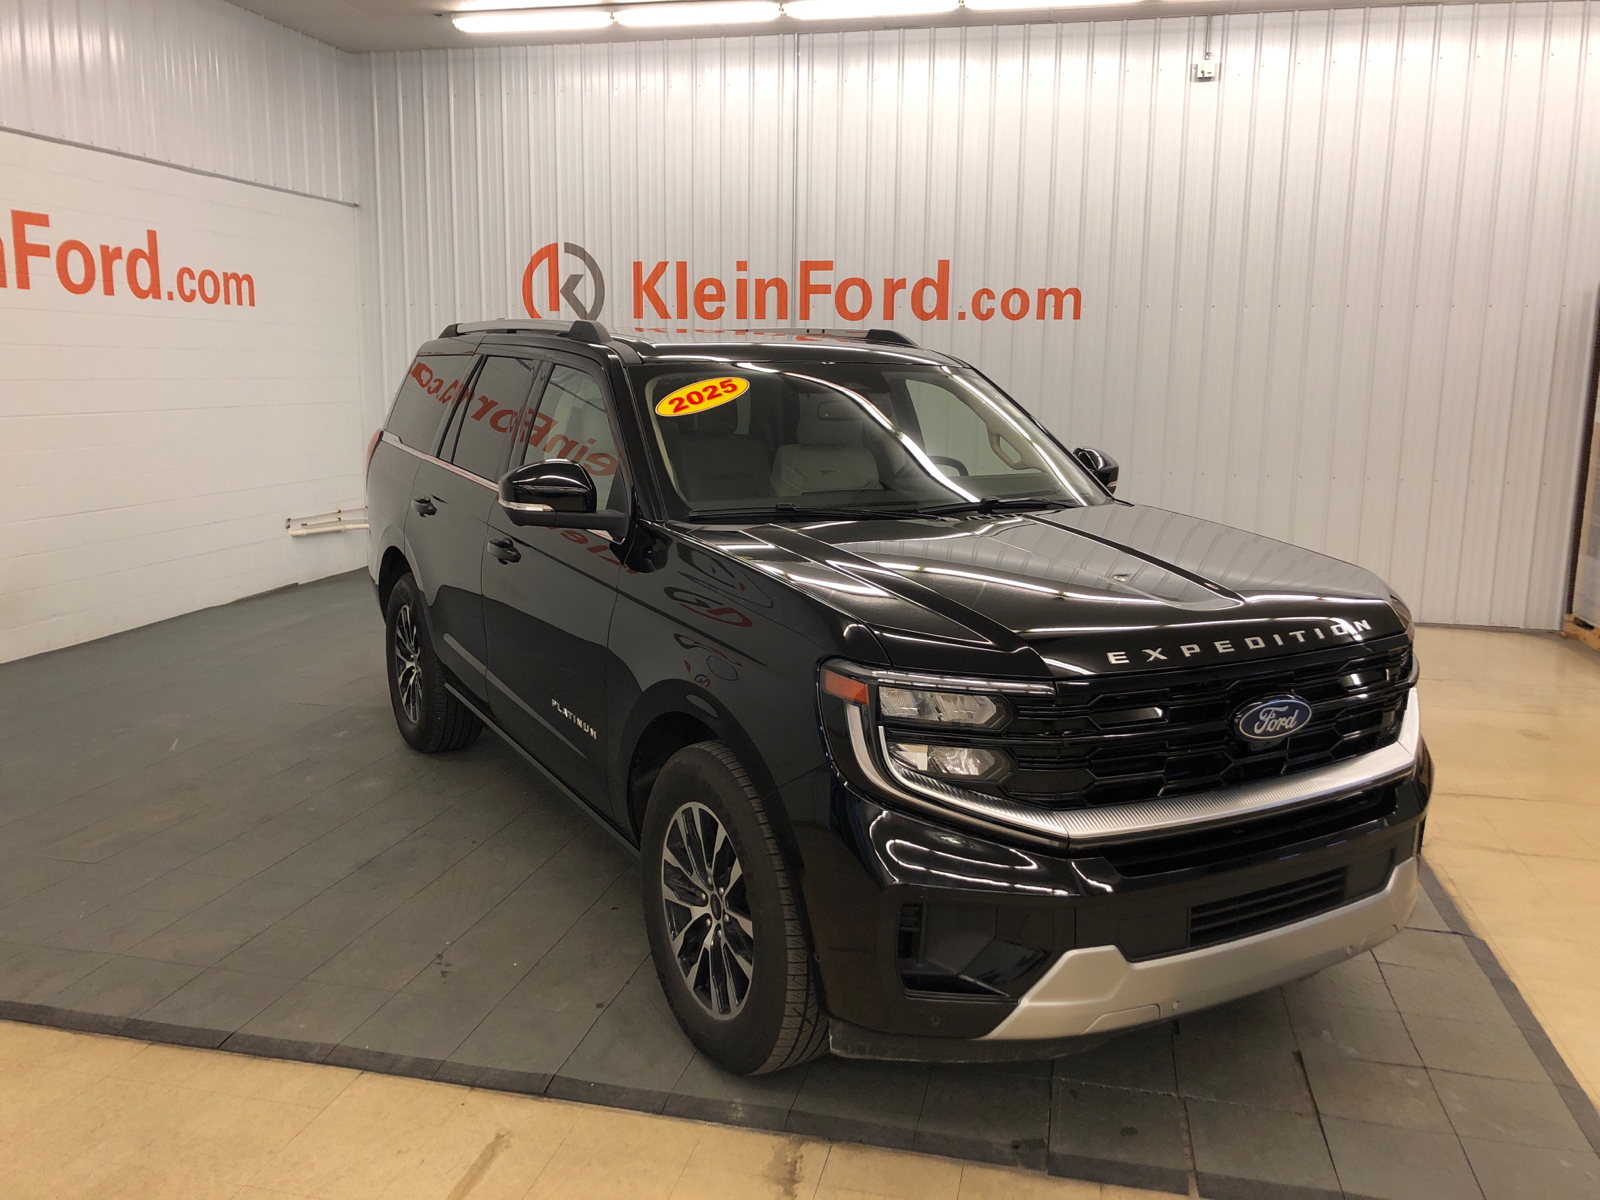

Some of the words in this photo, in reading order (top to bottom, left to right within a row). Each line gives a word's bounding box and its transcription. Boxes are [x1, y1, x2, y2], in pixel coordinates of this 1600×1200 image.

[0, 209, 256, 307] Ford.com
[632, 259, 1082, 322] KleinFord.com
[668, 379, 738, 413] 2025
[1106, 619, 1372, 665] EXPEDITION
[552, 698, 597, 740] PLATINUM
[1254, 705, 1299, 734] Ford
